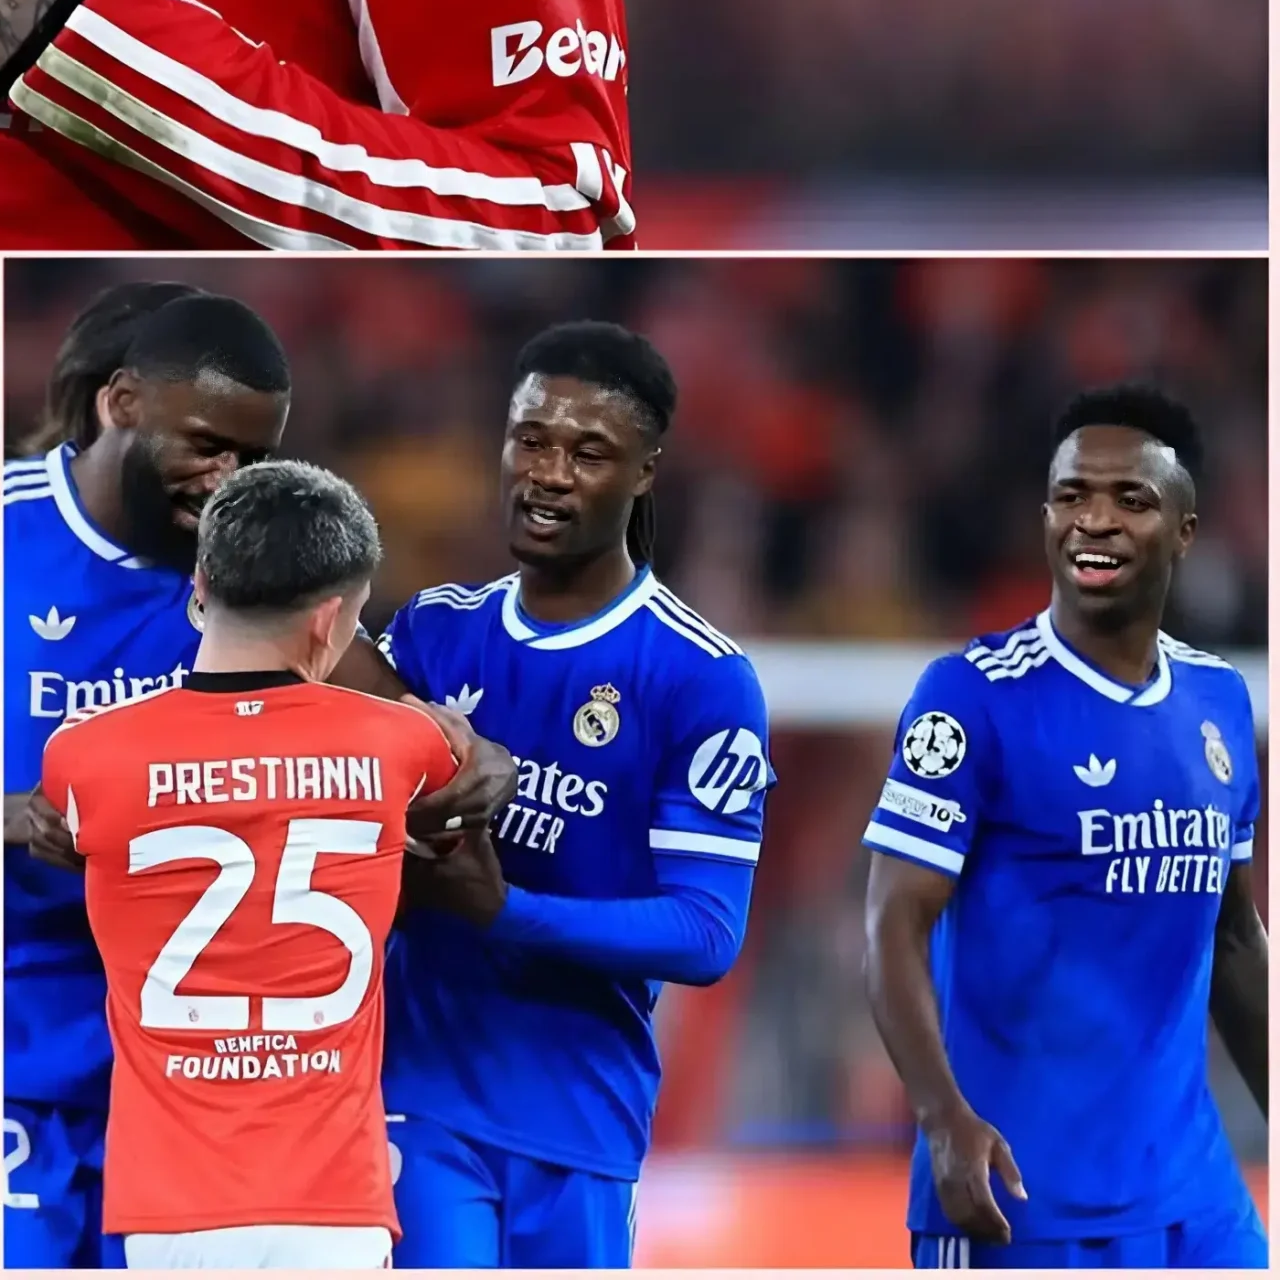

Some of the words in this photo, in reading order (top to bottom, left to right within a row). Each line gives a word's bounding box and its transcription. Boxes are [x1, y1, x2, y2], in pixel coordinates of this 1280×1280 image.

[147, 756, 383, 808] PRESTIANNI
[690, 726, 764, 815] hp
[1077, 799, 1231, 855] Emirate
[1105, 854, 1151, 894] FLY
[1155, 854, 1223, 894] BETTE
[128, 818, 383, 1032] 25
[165, 1049, 341, 1080] FOUNDATION
